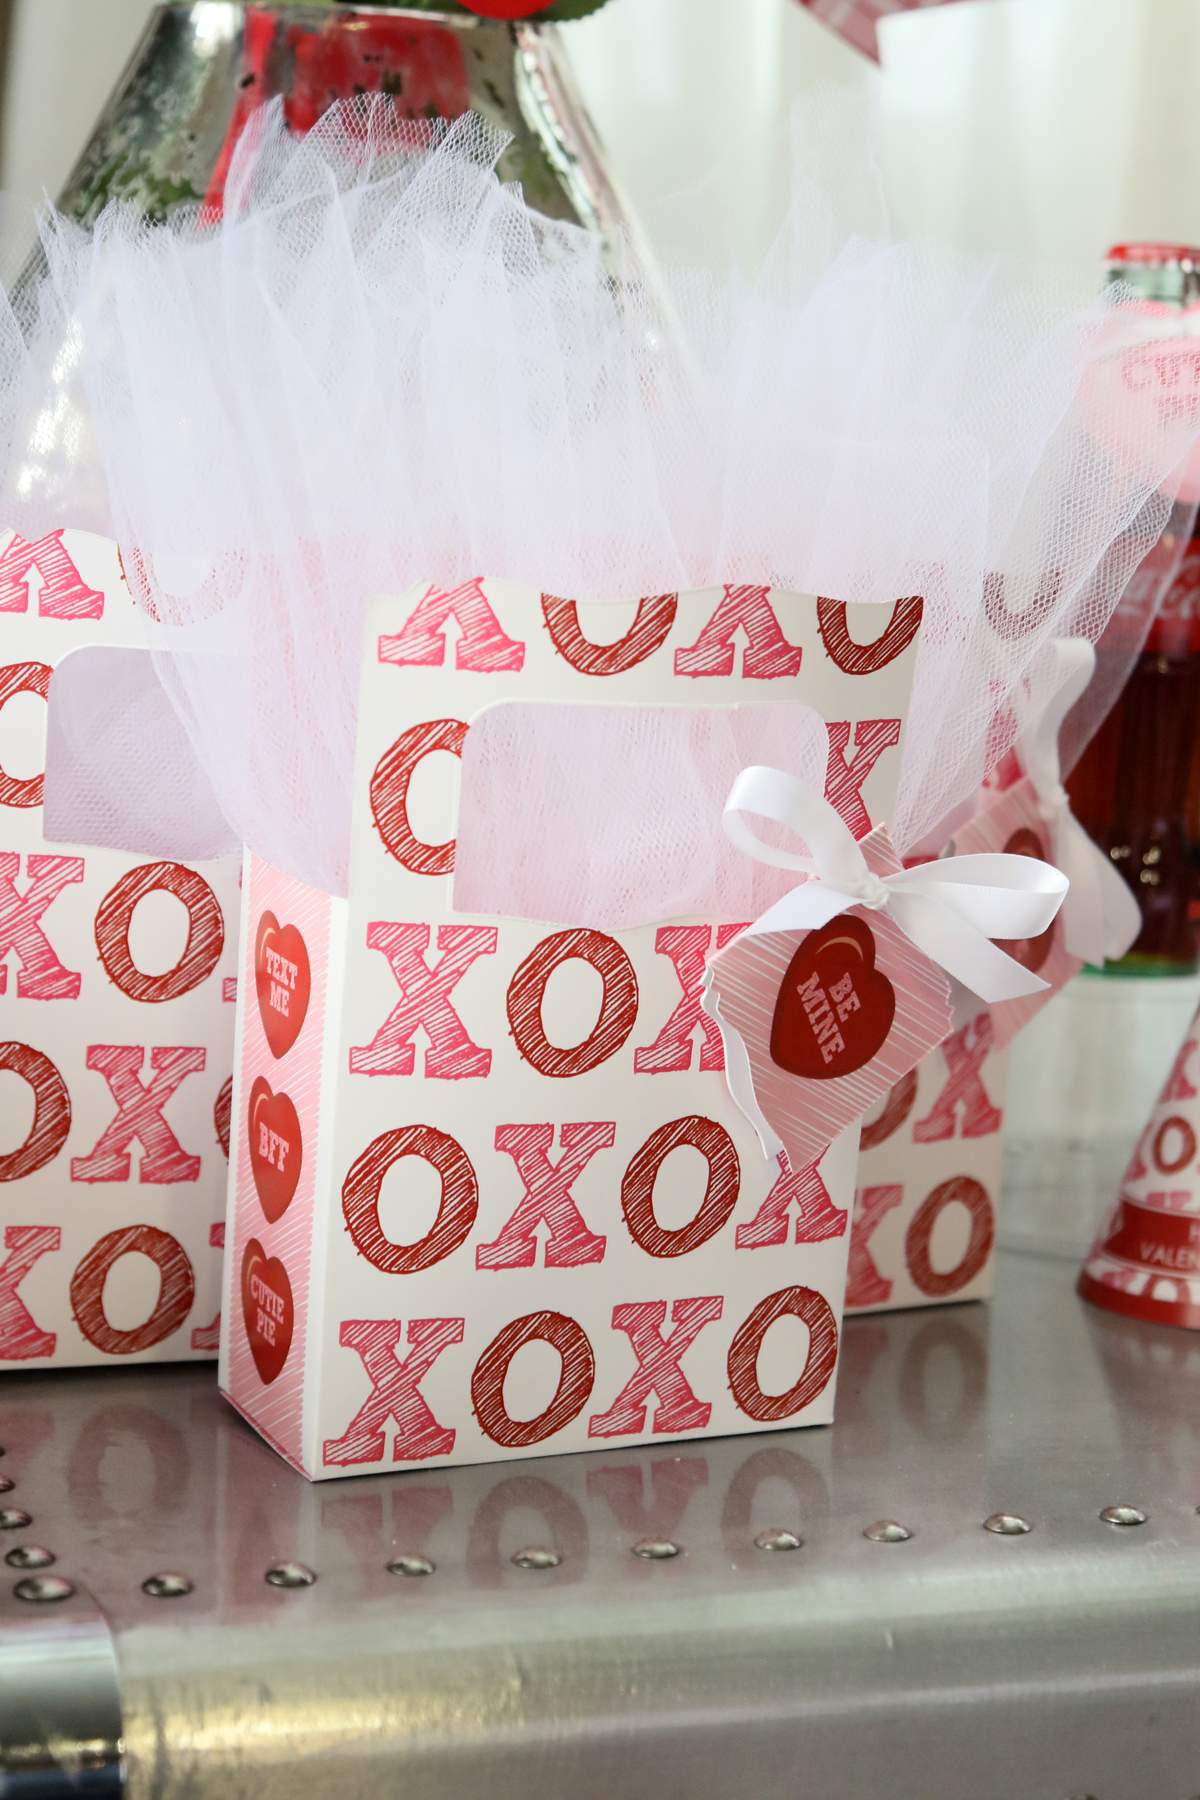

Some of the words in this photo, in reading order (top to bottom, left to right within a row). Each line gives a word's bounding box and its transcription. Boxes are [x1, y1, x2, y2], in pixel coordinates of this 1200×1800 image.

[265, 946, 299, 991] TEXT
[268, 980, 290, 1018] ME
[796, 970, 846, 1065] MINE
[828, 971, 862, 1024] BE
[258, 1121, 290, 1173] BFF
[250, 1273, 285, 1325] CUTIE
[255, 1310, 276, 1347] PIE
